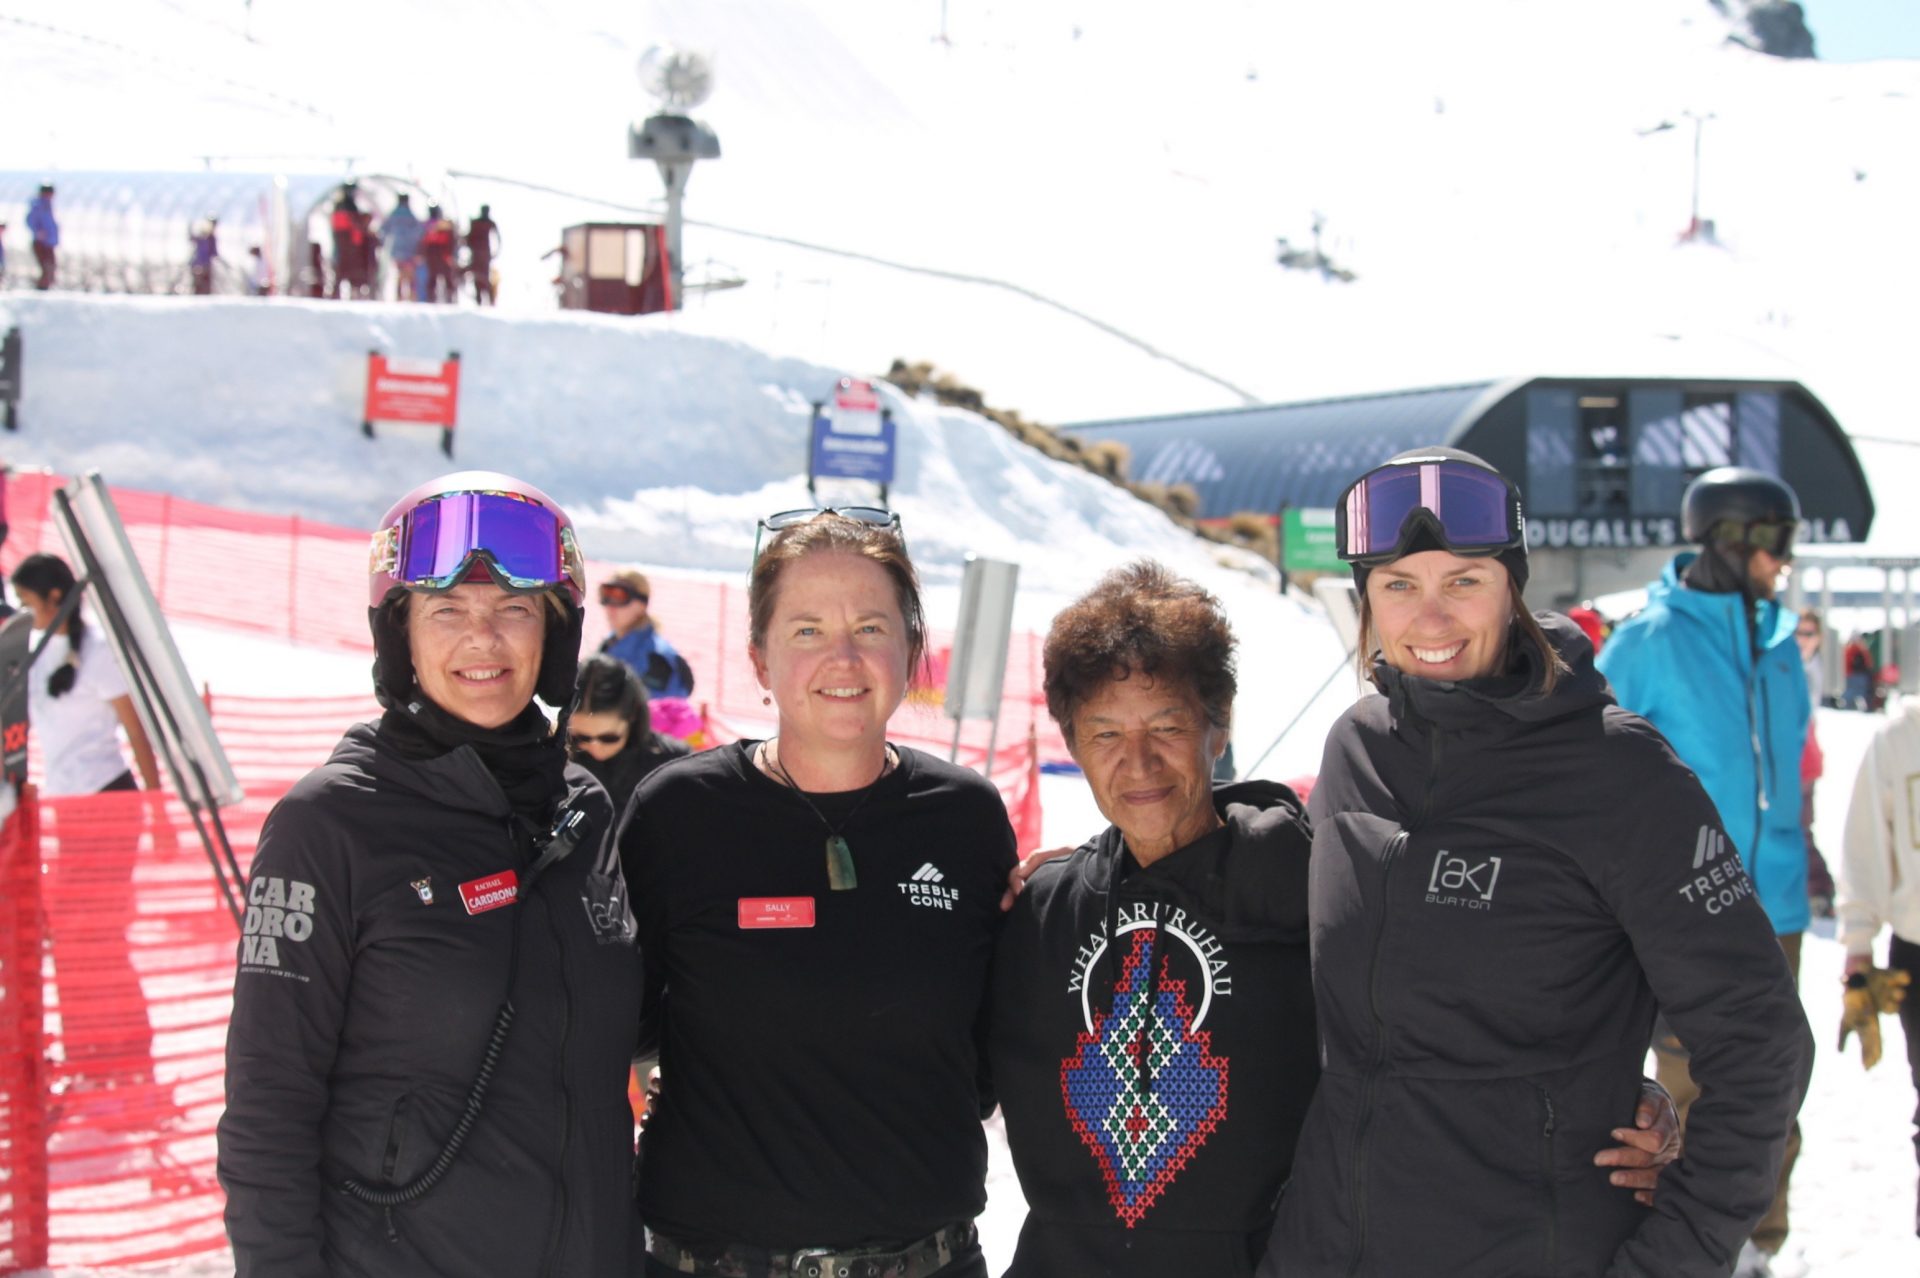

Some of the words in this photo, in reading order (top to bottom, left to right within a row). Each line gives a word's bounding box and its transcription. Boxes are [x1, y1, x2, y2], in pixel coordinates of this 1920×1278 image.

[1526, 518, 1676, 547] OUGALL'S
[248, 876, 316, 915] CAR
[897, 883, 959, 901] TREBLE
[910, 895, 953, 911] CONE
[1425, 893, 1491, 911] BURTON
[1705, 876, 1753, 915] CONE
[765, 903, 791, 913] SALLY
[243, 906, 313, 943] DRO
[241, 936, 280, 967] NA
